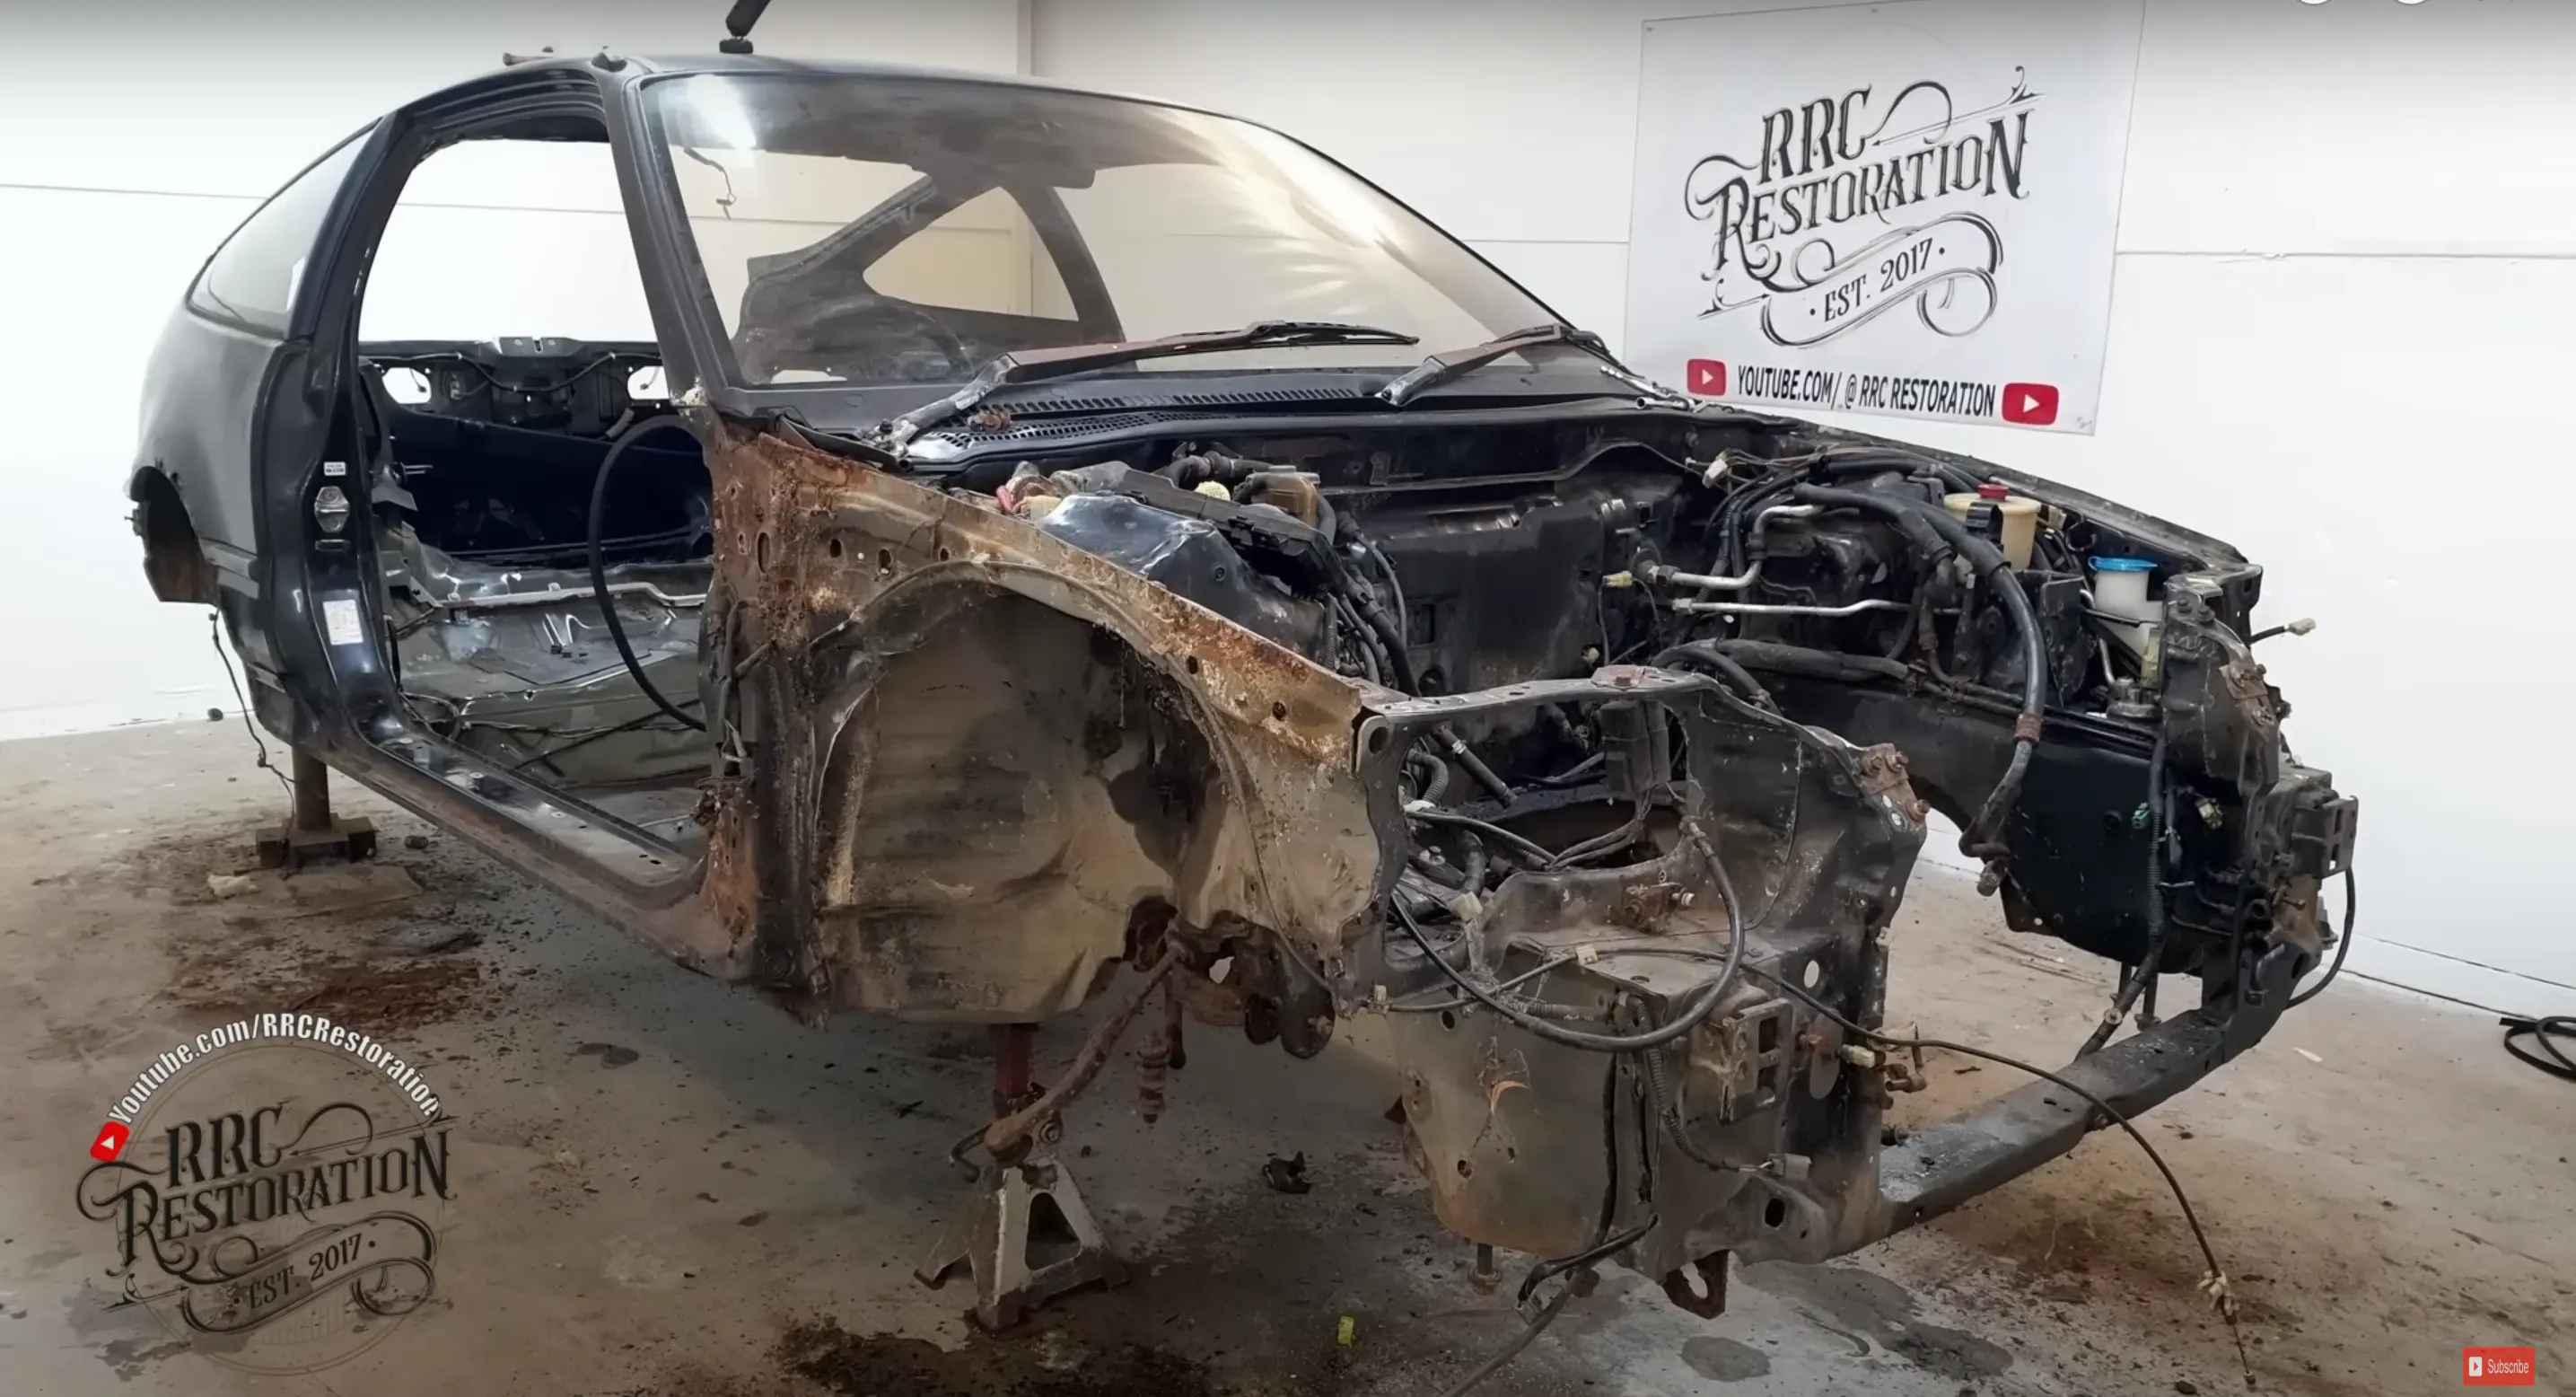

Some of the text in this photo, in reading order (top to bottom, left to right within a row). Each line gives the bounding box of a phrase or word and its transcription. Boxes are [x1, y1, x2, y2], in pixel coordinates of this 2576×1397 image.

[1757, 83, 1874, 186] RRC
[1695, 107, 2035, 281] RESTORATION
[1824, 237, 1933, 322] EST. 2017
[1844, 373, 1857, 410] @
[1859, 374, 1888, 409] RRC
[1890, 377, 1997, 417] RESTORATION
